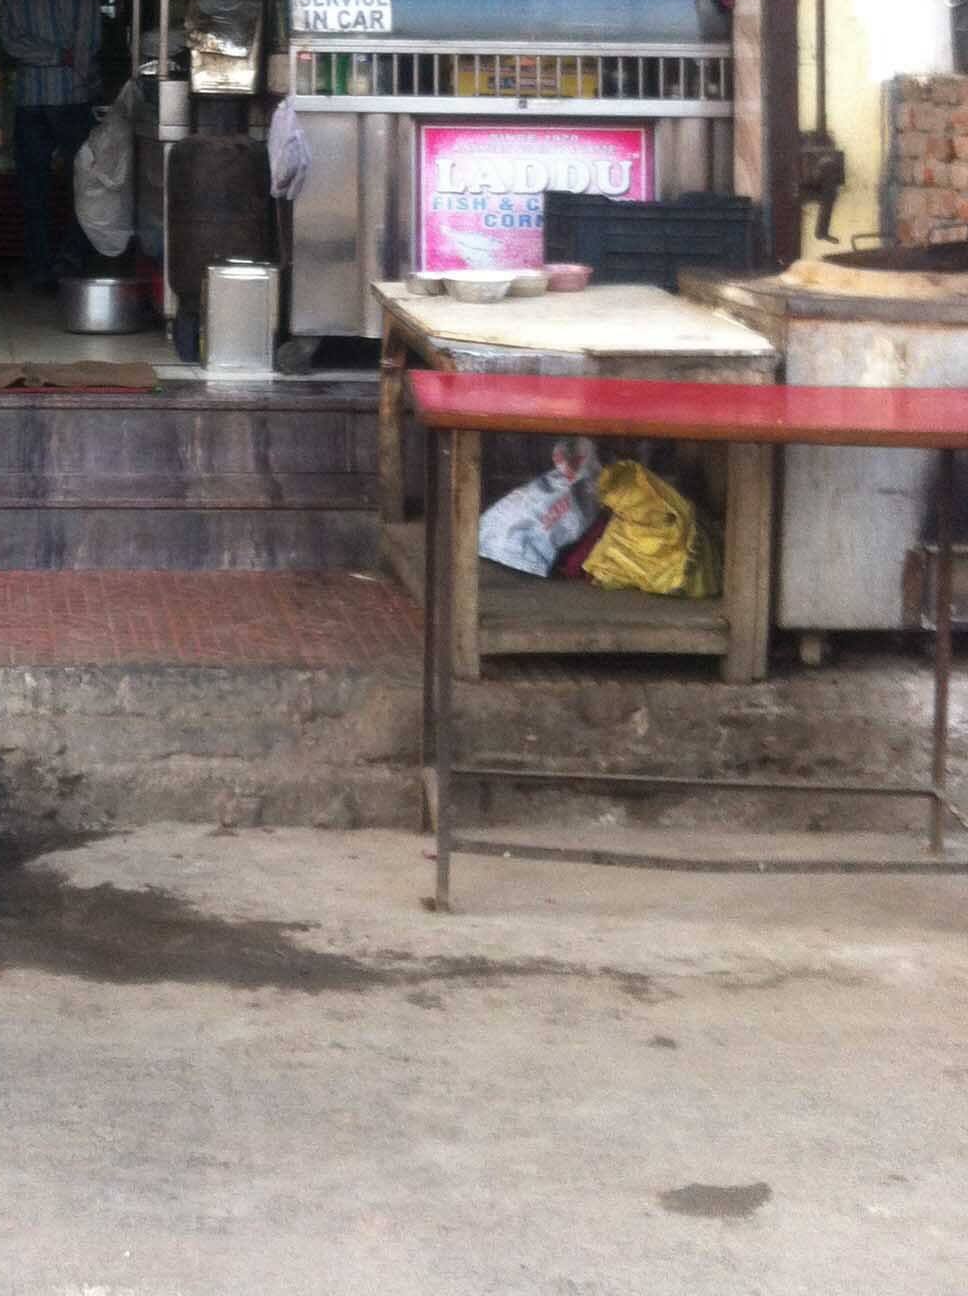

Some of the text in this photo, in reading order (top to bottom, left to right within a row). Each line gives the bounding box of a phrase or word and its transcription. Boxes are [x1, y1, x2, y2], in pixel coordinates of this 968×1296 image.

[304, 10, 385, 29] IN CAR
[435, 158, 634, 195] LADDU
[433, 197, 486, 211] FISH
[499, 197, 514, 211] &
